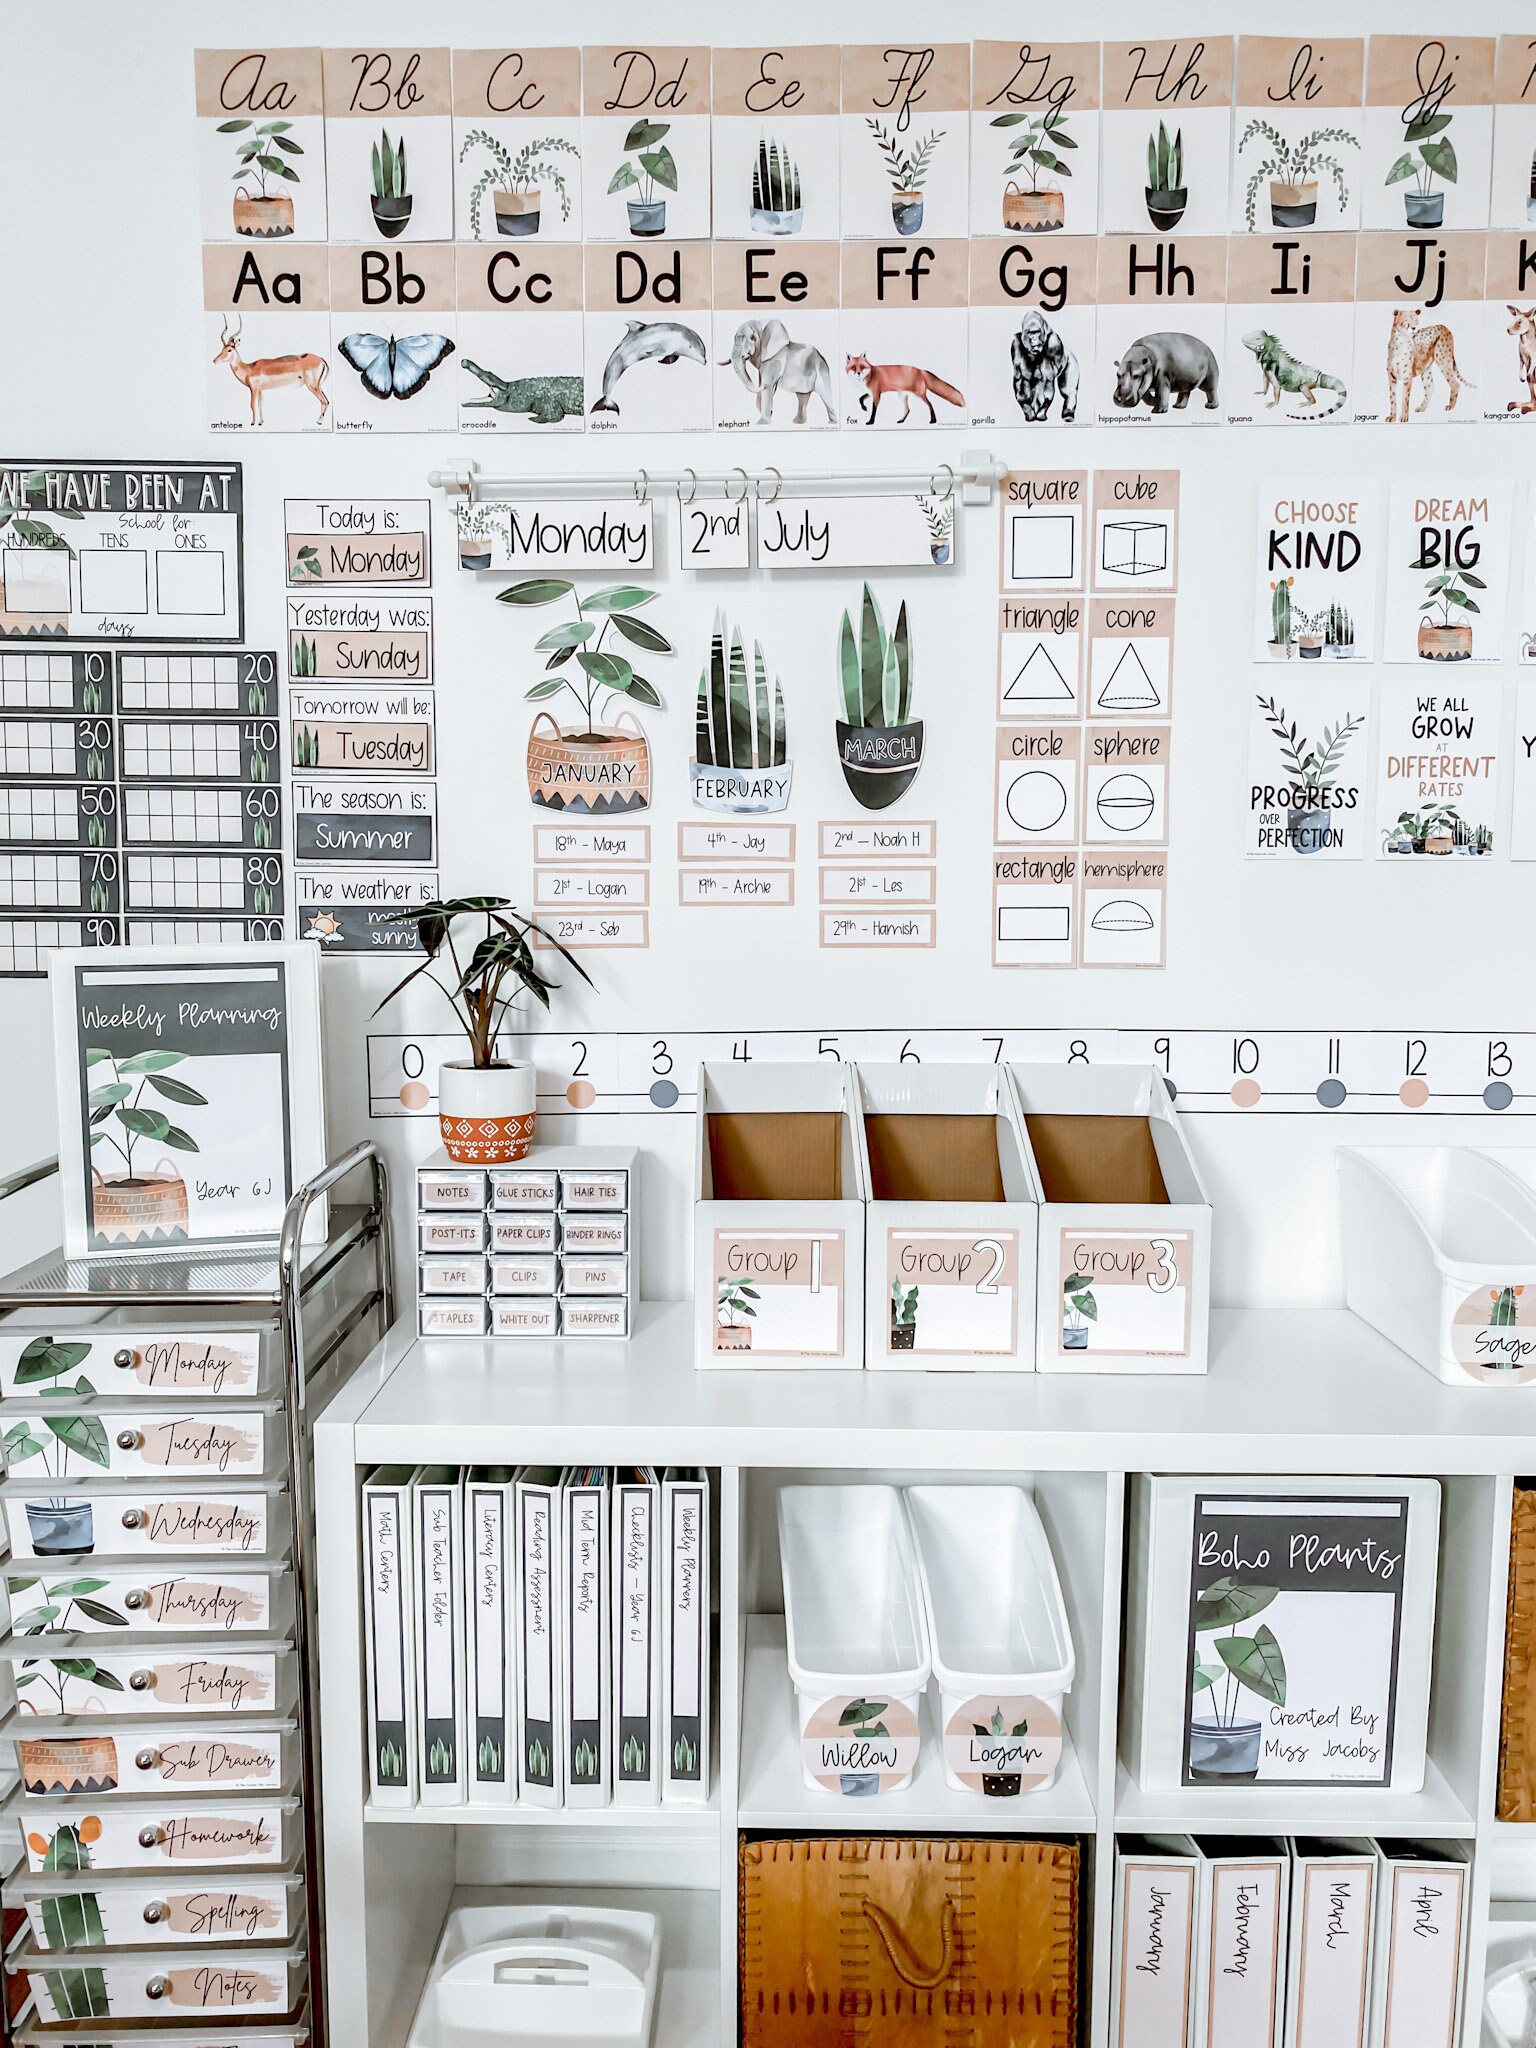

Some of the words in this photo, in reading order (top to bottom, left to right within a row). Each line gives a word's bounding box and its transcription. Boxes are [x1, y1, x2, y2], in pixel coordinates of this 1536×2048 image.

[232, 251, 301, 304] Aa
[361, 252, 426, 304] Bb
[487, 251, 552, 304] Cc
[616, 251, 682, 304] Dd
[745, 249, 808, 303] Ee
[211, 422, 242, 430] antelope
[337, 421, 373, 431] butterfly
[461, 421, 496, 429] crocodile
[591, 422, 617, 430] dolphin
[718, 420, 750, 429] elephant
[846, 416, 858, 425] fox
[971, 416, 995, 425] gorilla
[1098, 415, 1151, 423] hippopotamus
[1227, 415, 1252, 424] iguana
[1353, 414, 1379, 422] jaguar
[1484, 412, 1520, 421] kangaroo
[44, 472, 112, 510] HAVE
[124, 473, 184, 511] BEEN
[199, 474, 231, 511] AT
[1008, 479, 1079, 509] square
[1114, 479, 1158, 501] cube
[316, 504, 378, 534] Today
[383, 508, 400, 529] is:
[1275, 500, 1358, 524] CHOOSE
[1415, 498, 1489, 522] DREAM
[7, 532, 66, 548] HUNDREDS
[99, 533, 129, 548] TENS
[175, 533, 207, 549] ONES
[511, 511, 646, 562] Monday
[691, 507, 740, 554] 2nd
[764, 509, 830, 561] July
[330, 545, 421, 577] Monday
[1268, 530, 1361, 572] KIND
[1420, 525, 1481, 569] BIG
[289, 602, 382, 632] Yesterday
[389, 608, 430, 628] was:
[1003, 602, 1079, 634] triangle
[1106, 607, 1156, 629] cone
[243, 653, 274, 684] 20
[336, 641, 421, 676] Sunday
[293, 695, 378, 715] Tomorrow
[386, 696, 408, 716] will
[413, 696, 431, 716] be:
[1417, 697, 1437, 712] WE
[1443, 697, 1469, 711] ALL
[1412, 716, 1473, 739] GROW
[336, 730, 425, 767] Tuesday
[844, 736, 916, 760] MARCH
[1012, 731, 1063, 757] circle
[1094, 731, 1160, 764] sphere
[1435, 743, 1448, 751] AT
[542, 762, 637, 784] JANUARY
[1387, 756, 1495, 778] DIFFERENT
[296, 785, 333, 809] The
[341, 790, 402, 809] season
[410, 790, 427, 810] is:
[696, 778, 787, 798] FEBRUARY
[1251, 785, 1358, 810] PROGRESS
[1419, 782, 1464, 797] RATES
[1259, 813, 1280, 824] OVER
[315, 823, 412, 850] Summer
[555, 834, 577, 852] 18th
[594, 838, 626, 853] Maya
[707, 832, 726, 848] 4th
[743, 837, 765, 852] Jay
[1258, 828, 1343, 848] PERFECTION
[848, 876, 866, 893] 21st
[884, 877, 903, 893] Les
[995, 856, 1076, 884] rectangle
[1084, 860, 1164, 882] hemisphere
[299, 877, 333, 899] The
[341, 879, 412, 900] weather
[420, 883, 434, 900] is:
[553, 878, 571, 896] 21st
[588, 881, 627, 898] Logan
[699, 878, 717, 895] 19th
[733, 878, 770, 894] Archie
[372, 930, 417, 948] sunny
[558, 921, 583, 937] 23rd
[600, 921, 620, 937] Seb
[833, 919, 856, 937] 29th
[873, 920, 919, 937] Hamish
[82, 1001, 166, 1036] Weekly
[179, 1002, 282, 1030] Planning
[402, 1044, 424, 1079] 0
[572, 1041, 589, 1077] 2
[652, 1040, 673, 1075] 3
[1233, 1038, 1259, 1073] 10
[1329, 1038, 1341, 1074] 11
[1406, 1040, 1427, 1076] 12
[1487, 1041, 1513, 1077] 13
[196, 1179, 240, 1201] Year
[252, 1178, 272, 1196] 6J
[437, 1187, 469, 1197] NOTES
[496, 1187, 518, 1198] GLUE
[521, 1188, 554, 1198] STICKS
[574, 1187, 595, 1197] HAIR
[599, 1187, 616, 1197] TIES
[431, 1229, 475, 1239] POST-ITS
[497, 1228, 523, 1239] PAPER
[526, 1228, 551, 1239] CLIPS
[566, 1230, 595, 1239] BINDER
[597, 1230, 622, 1240] RINGS
[442, 1272, 466, 1282] TAPE
[512, 1272, 537, 1281] CLIPS
[585, 1272, 606, 1282] PINS
[728, 1244, 798, 1279] Group
[810, 1240, 820, 1293] 1
[901, 1246, 972, 1280] Group
[972, 1239, 1005, 1294] 2
[1073, 1244, 1145, 1280] Group
[1147, 1239, 1178, 1293] 3
[433, 1314, 473, 1323] STAPLES
[500, 1314, 529, 1324] WHITE
[532, 1314, 550, 1324] OUT
[569, 1314, 620, 1323] SHARPENER
[1475, 1331, 1536, 1362] Sage
[145, 1342, 232, 1394] Monday
[159, 1418, 237, 1471] Tuesday
[151, 1504, 260, 1550] Wednesday
[379, 1511, 391, 1545] Math
[480, 1509, 497, 1559] Literacy
[582, 1509, 594, 1530] Mid
[676, 1507, 696, 1554] Weekly
[529, 1511, 545, 1562] Reading
[581, 1536, 595, 1566] Term
[1198, 1531, 1270, 1569] Boho
[1288, 1534, 1402, 1579] Plants
[377, 1550, 394, 1594] Centers
[481, 1564, 498, 1608] Centers
[678, 1558, 696, 1612] Planners
[151, 1577, 242, 1629] Thursday
[529, 1568, 547, 1636] Assessment
[577, 1572, 595, 1614] Reports
[178, 1662, 249, 1709] Friday
[1270, 1705, 1340, 1728] Created
[1350, 1706, 1379, 1735] By
[159, 1745, 200, 1778] Sub
[205, 1744, 275, 1777] Drawer
[822, 1743, 897, 1769] Willow
[970, 1739, 1042, 1770] Logan
[1265, 1739, 1309, 1763] Miss
[1323, 1738, 1380, 1763] Jacobs
[158, 1817, 270, 1858] Homework
[186, 1894, 264, 1934] Spelling
[1327, 1882, 1351, 1950] March
[1412, 1886, 1442, 1938] April
[1136, 1886, 1171, 1975] January
[1223, 1883, 1259, 1978] February
[194, 1967, 257, 2006] Notes
